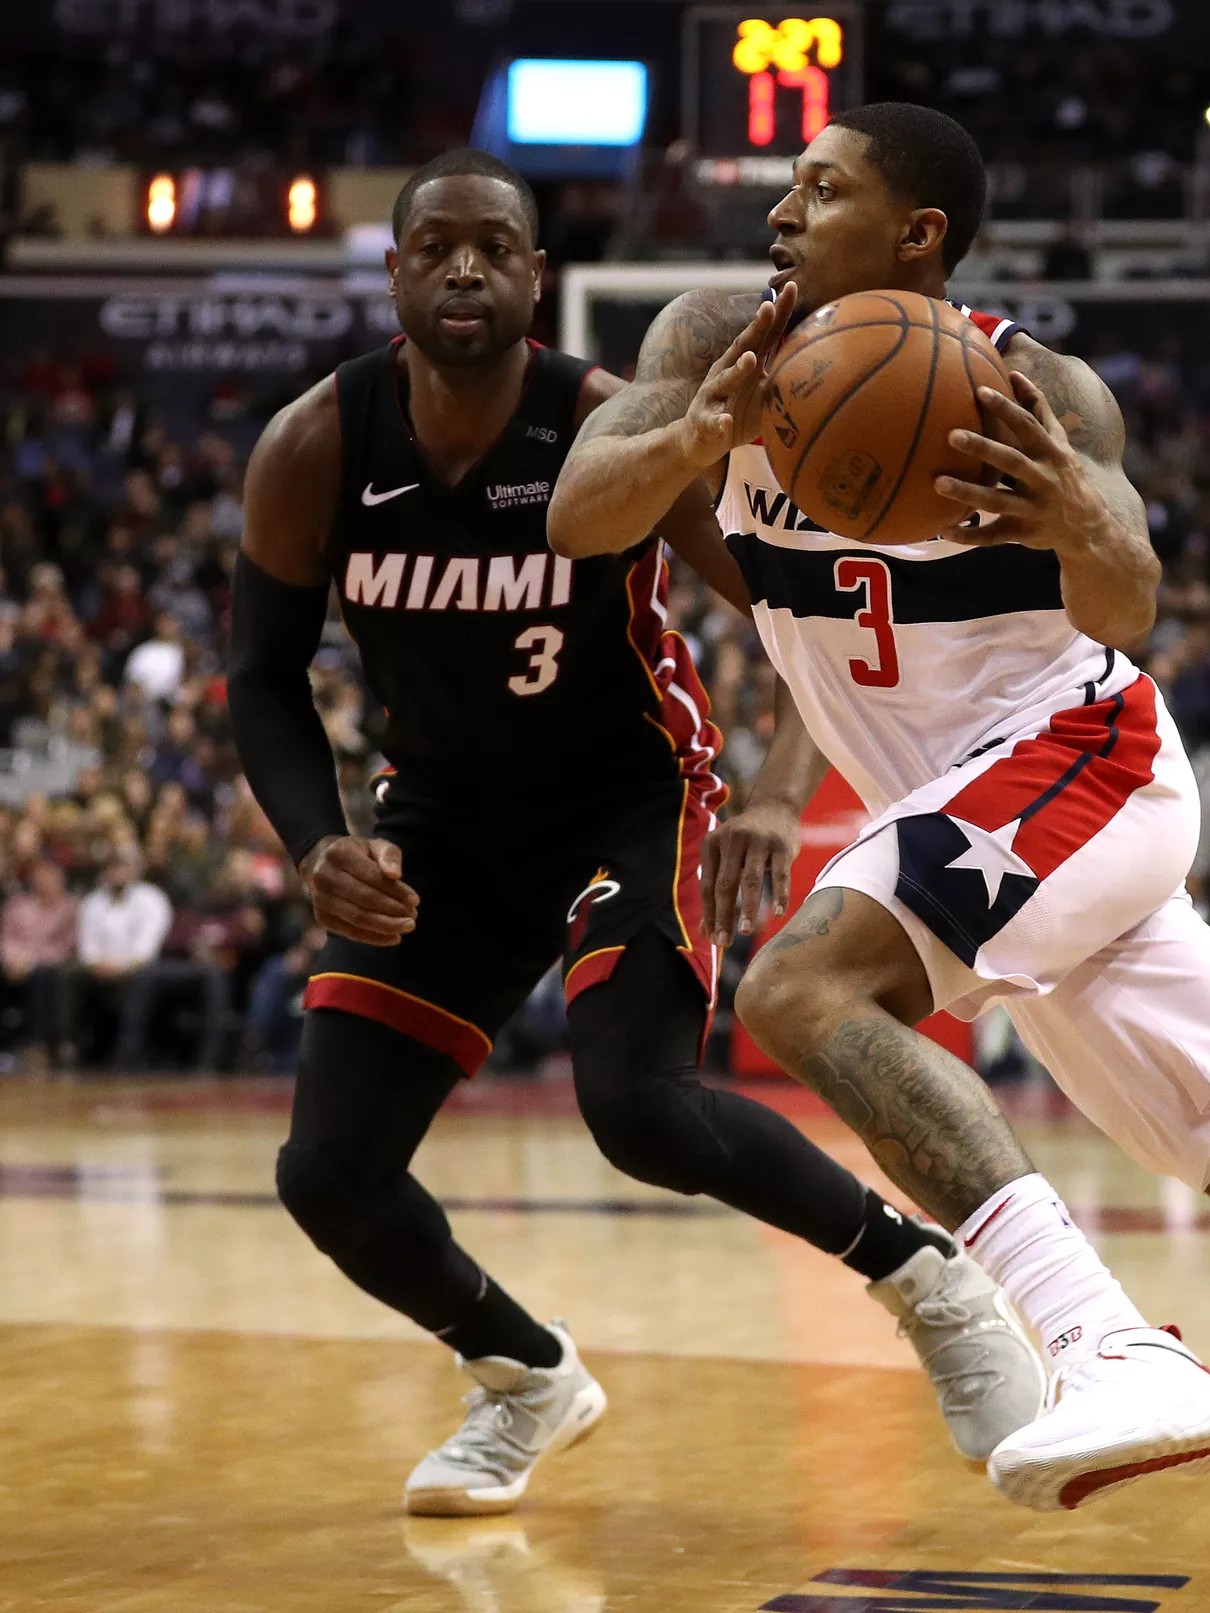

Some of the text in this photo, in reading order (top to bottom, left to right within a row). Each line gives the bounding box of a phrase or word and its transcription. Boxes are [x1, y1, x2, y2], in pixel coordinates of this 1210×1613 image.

[748, 65, 829, 147] 17
[526, 425, 558, 443] MSD
[486, 480, 550, 501] Ultimate
[491, 493, 550, 509] SOFTWARE
[344, 552, 573, 611] MIAMI
[833, 556, 902, 690] 3
[507, 624, 565, 697] 3
